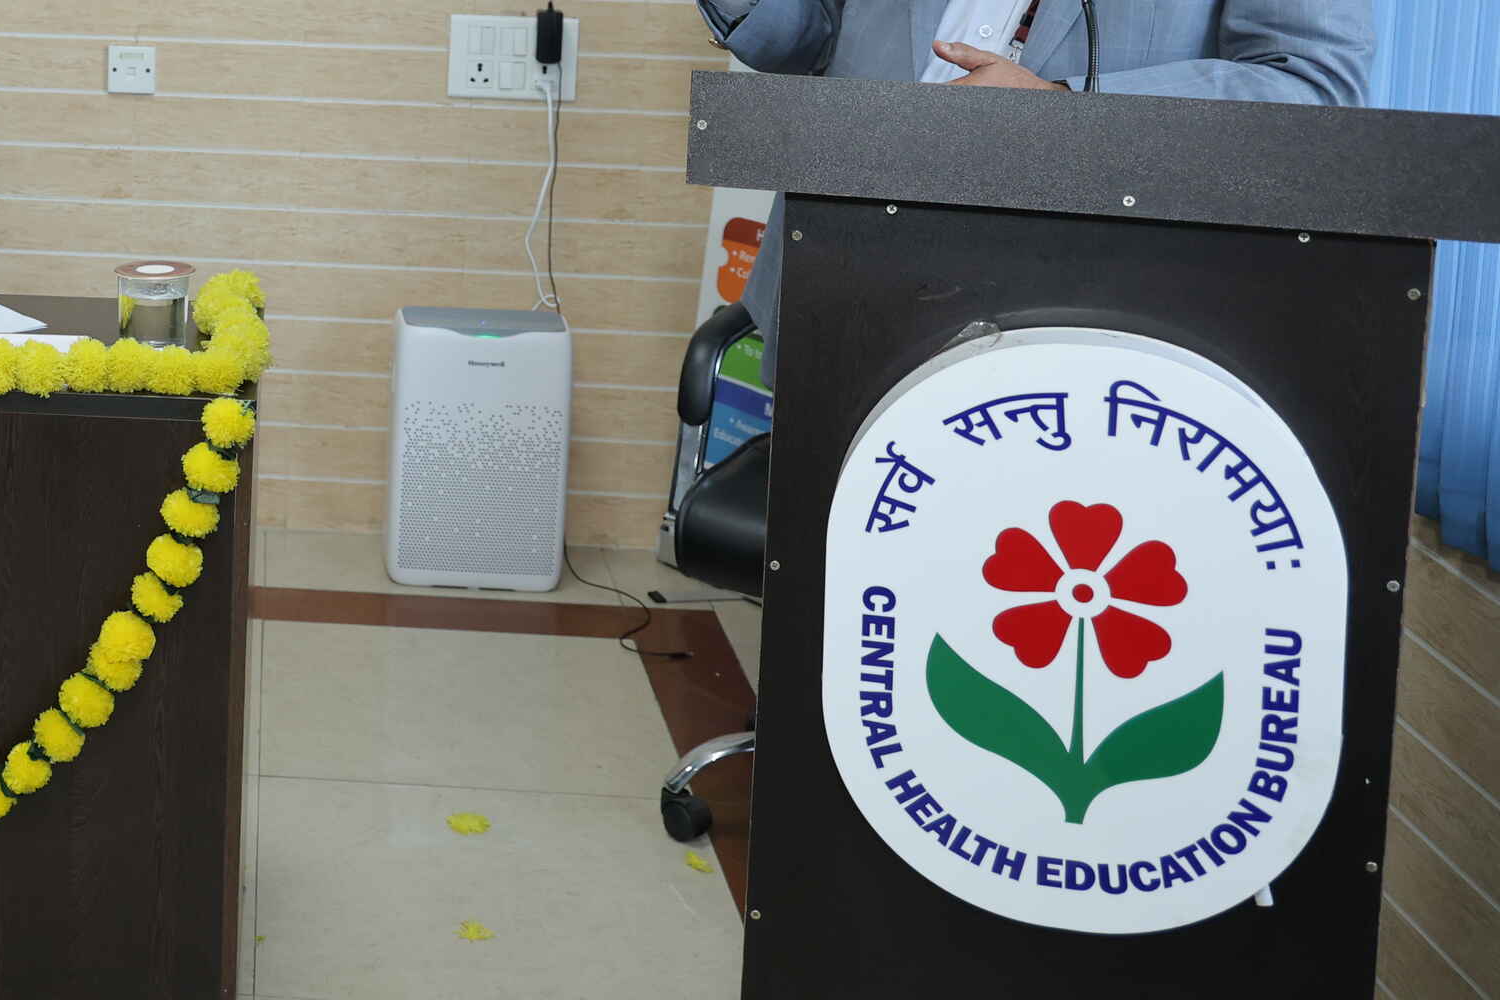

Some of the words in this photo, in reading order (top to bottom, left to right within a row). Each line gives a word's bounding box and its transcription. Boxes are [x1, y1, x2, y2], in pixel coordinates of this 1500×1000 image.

[864, 440, 935, 533] सर्वे
[942, 391, 1072, 452] सन्तु
[1102, 380, 1304, 571] निरामयाः
[860, 585, 903, 770] CENTRAL
[884, 769, 1028, 881] HEALTH
[1035, 798, 1273, 895] EDUCATION
[1247, 627, 1303, 803] BUREAU
